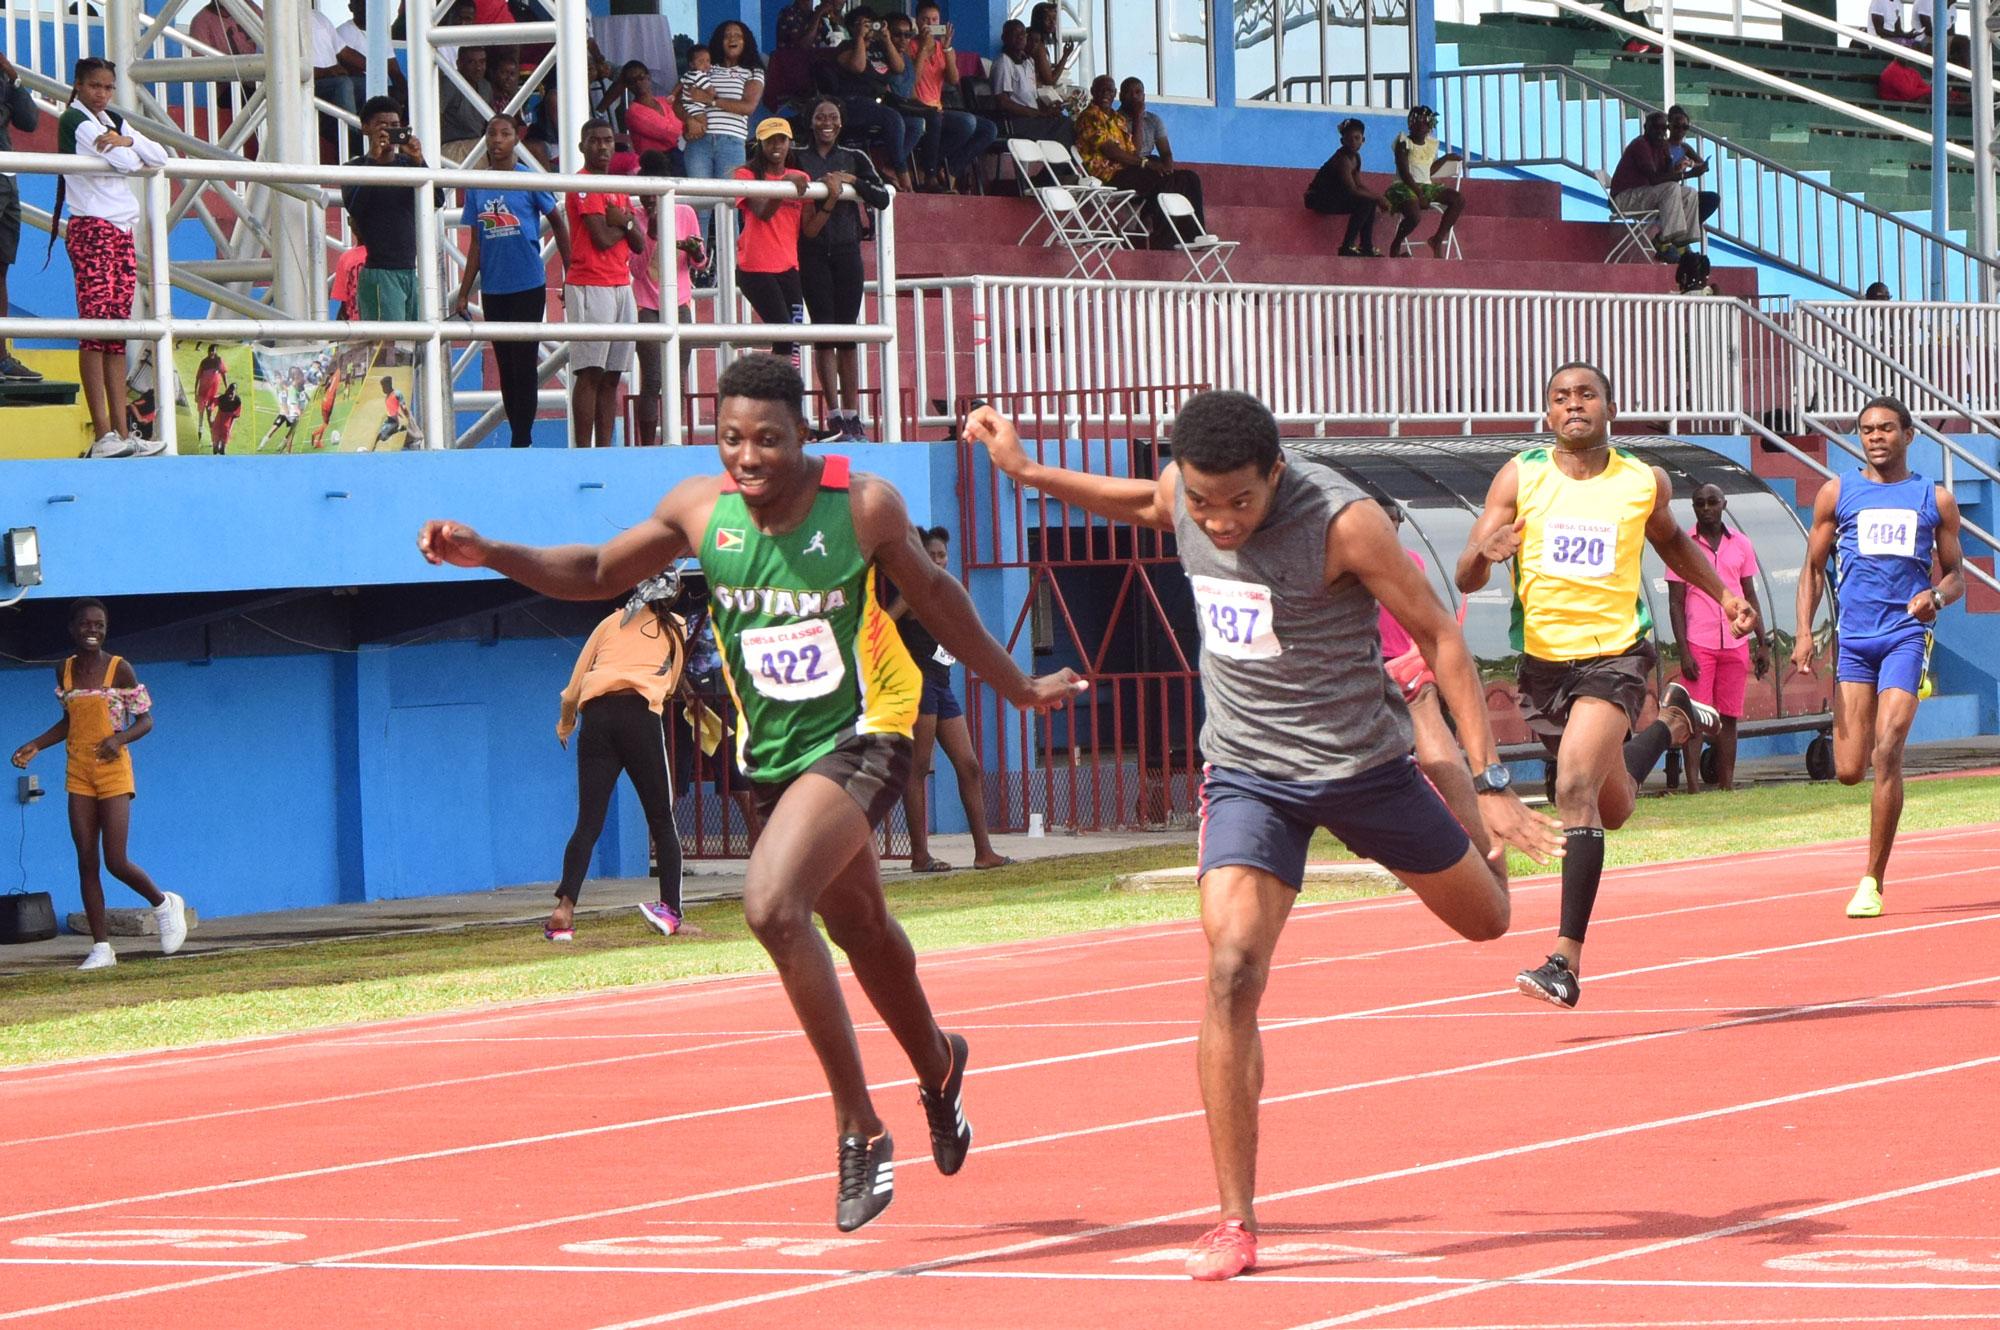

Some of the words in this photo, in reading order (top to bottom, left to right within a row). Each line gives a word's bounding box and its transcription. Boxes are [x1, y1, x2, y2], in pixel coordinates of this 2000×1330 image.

[1866, 523, 1907, 545] 404
[1553, 535, 1605, 566] 320
[715, 583, 848, 617] GUYANA
[778, 625, 824, 642] CLASSIC
[1208, 603, 1260, 644] 437
[761, 645, 828, 684] 422
